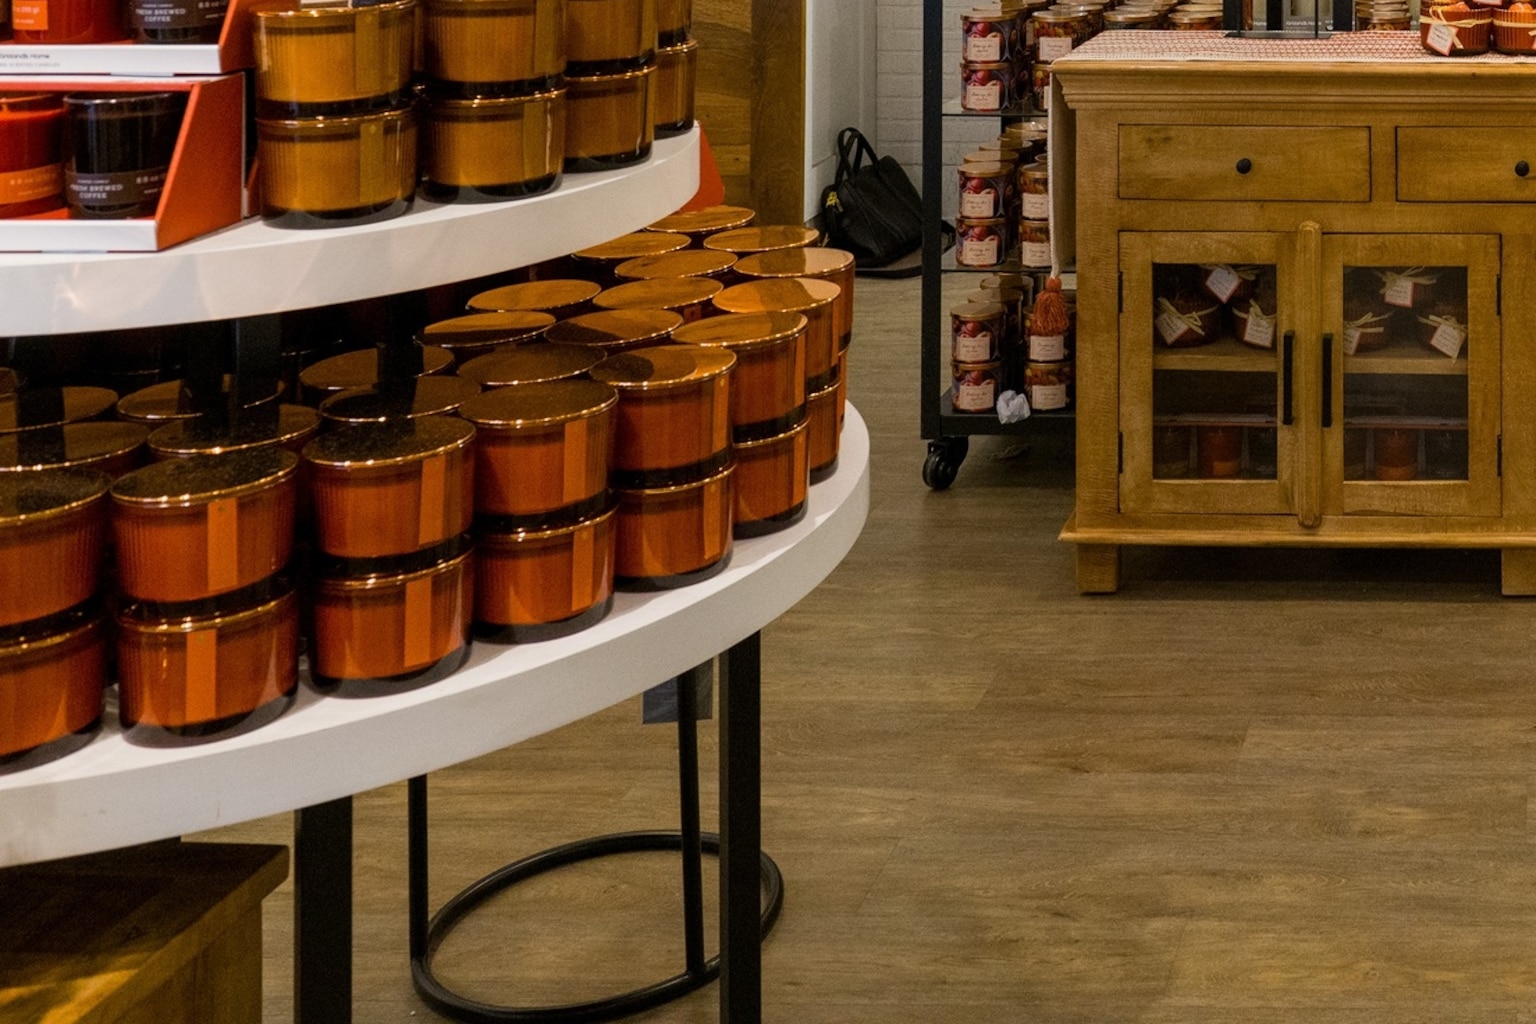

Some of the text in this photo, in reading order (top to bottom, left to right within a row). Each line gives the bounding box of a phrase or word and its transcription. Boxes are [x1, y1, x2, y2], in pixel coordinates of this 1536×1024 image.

[154, 8, 186, 16] BREWED
[144, 15, 171, 23] COFFEE
[89, 184, 123, 192] BREWED
